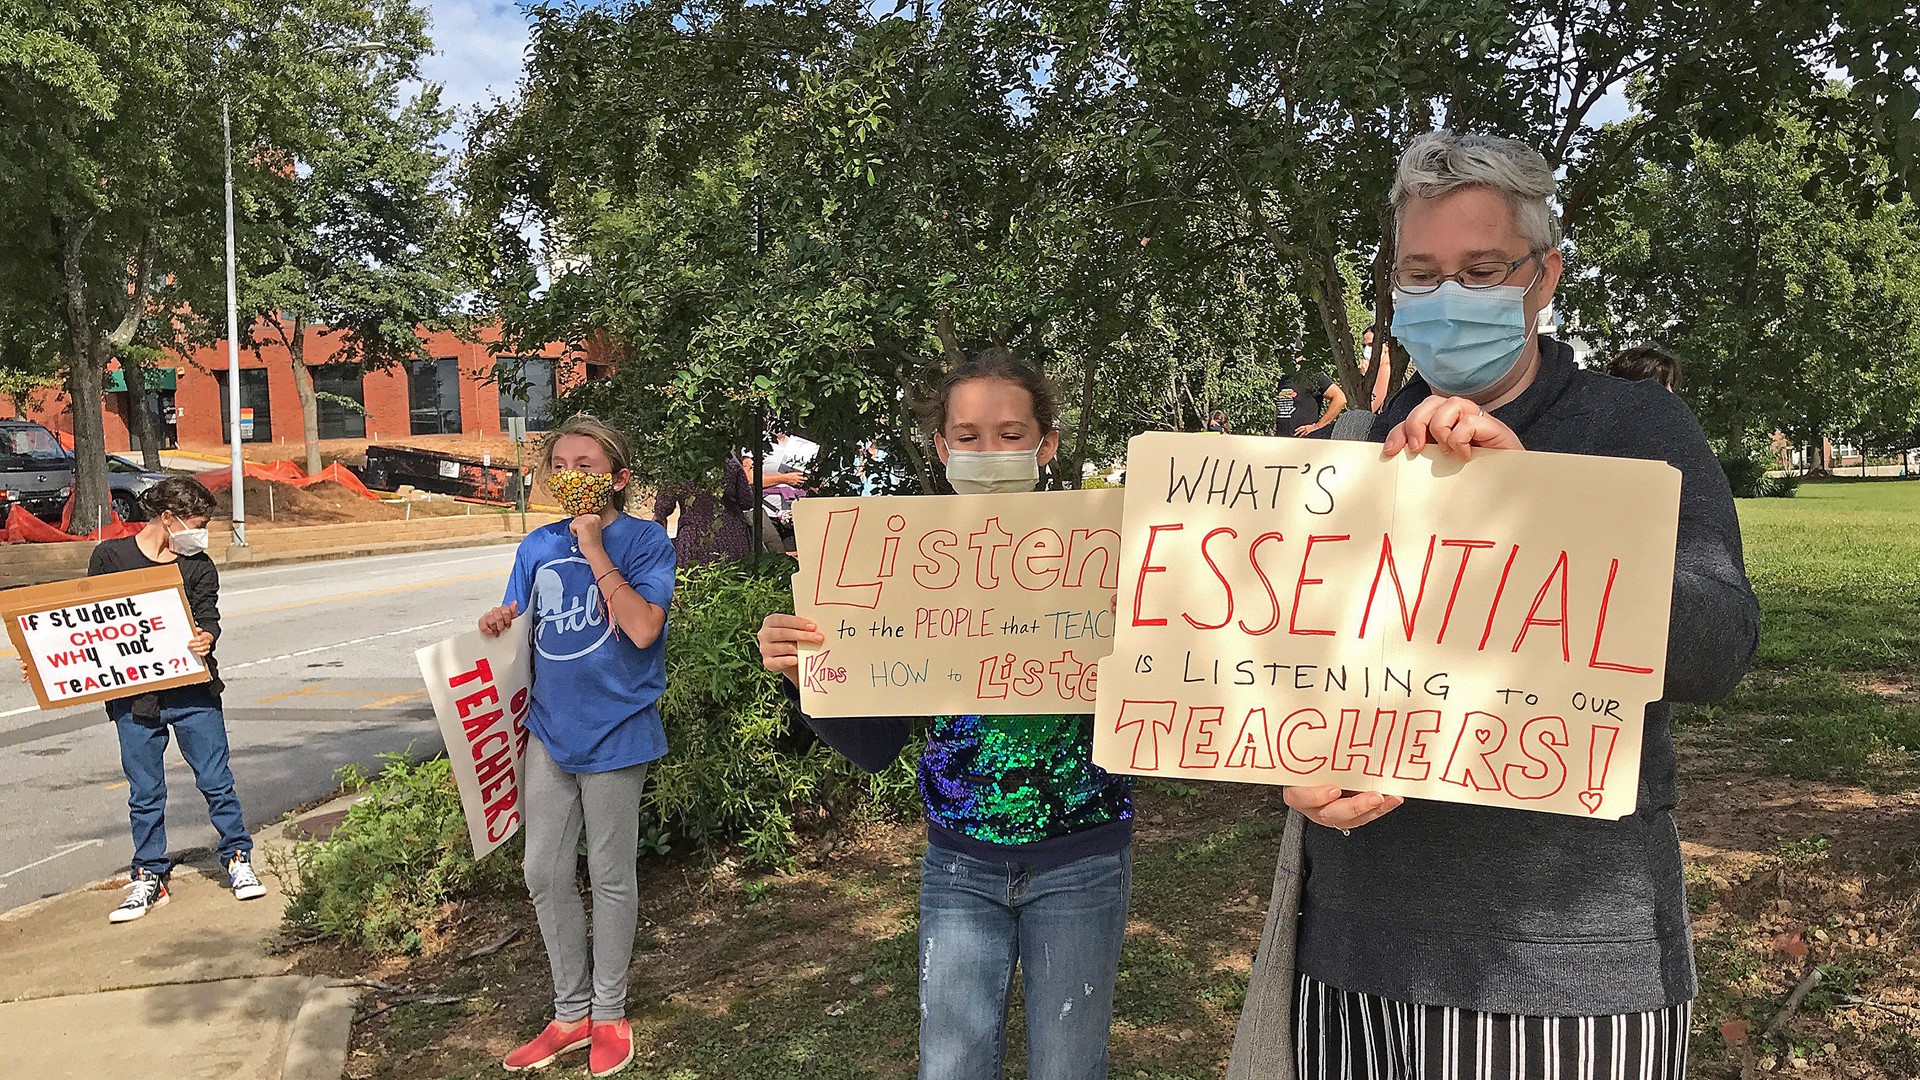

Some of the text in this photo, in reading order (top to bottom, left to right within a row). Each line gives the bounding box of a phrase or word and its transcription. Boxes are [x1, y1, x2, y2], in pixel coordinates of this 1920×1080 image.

[1165, 455, 1337, 515] WHAT'S
[814, 506, 1122, 609] Listen
[20, 598, 142, 631] If student
[836, 607, 1117, 640] to the PEOPLE that TEAC
[1130, 522, 1654, 675] ESSENTIAL
[116, 633, 154, 657] not
[871, 658, 930, 688] HOW
[946, 667, 963, 682] to
[976, 650, 1099, 702] Liste
[1134, 650, 1623, 721] IS LISTENING TO OUR
[448, 657, 521, 844] TEACHERS
[1114, 698, 1621, 814] TEACHERS!
